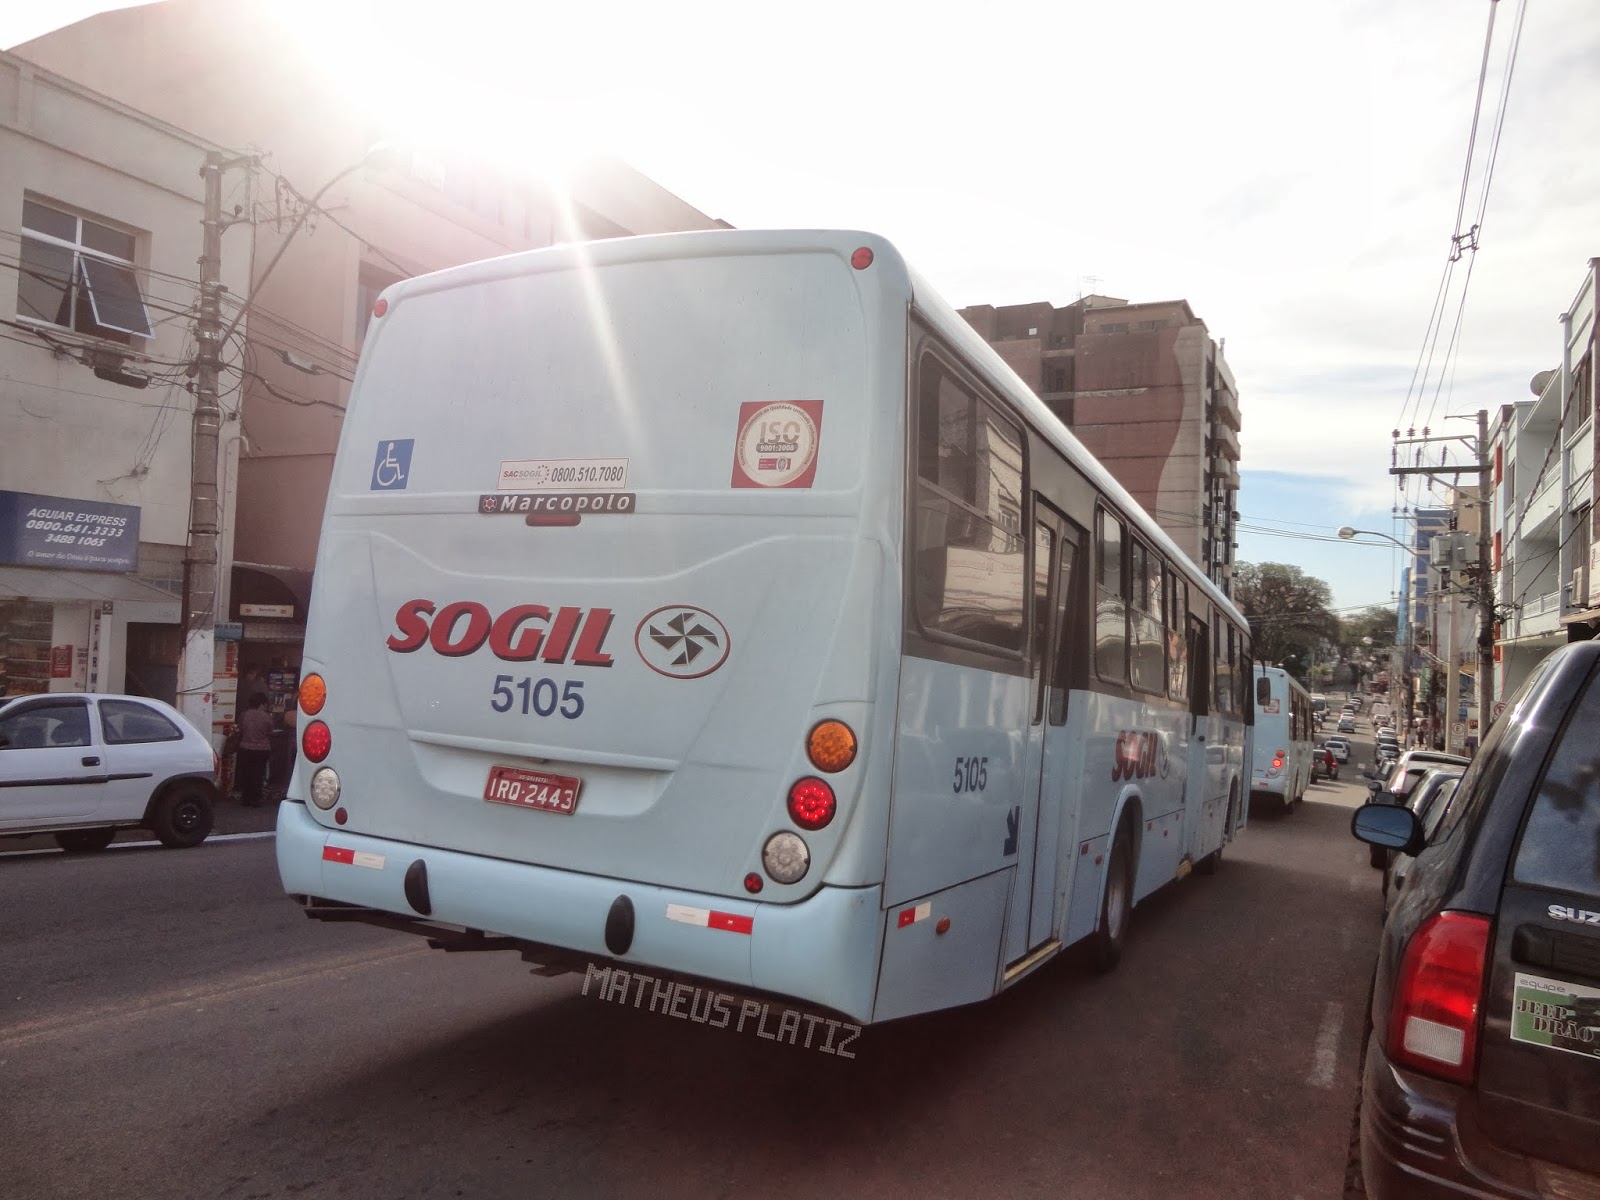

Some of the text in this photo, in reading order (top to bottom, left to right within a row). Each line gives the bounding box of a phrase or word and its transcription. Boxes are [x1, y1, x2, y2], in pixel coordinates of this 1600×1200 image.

[760, 421, 800, 443] ISO
[551, 466, 624, 482] 0800.510.7080
[500, 494, 630, 512] Marcopolo
[27, 508, 127, 527] AGUIAR EXPRESS
[26, 520, 124, 537] 0800.641.3333
[77, 537, 106, 547] 1065
[385, 598, 615, 668] SOGIL
[490, 674, 585, 719] 5105
[953, 756, 989, 794] 5105
[1520, 978, 1566, 993] equipe
[1516, 999, 1568, 1020] JEEP
[1533, 1016, 1594, 1043] DRÃO
